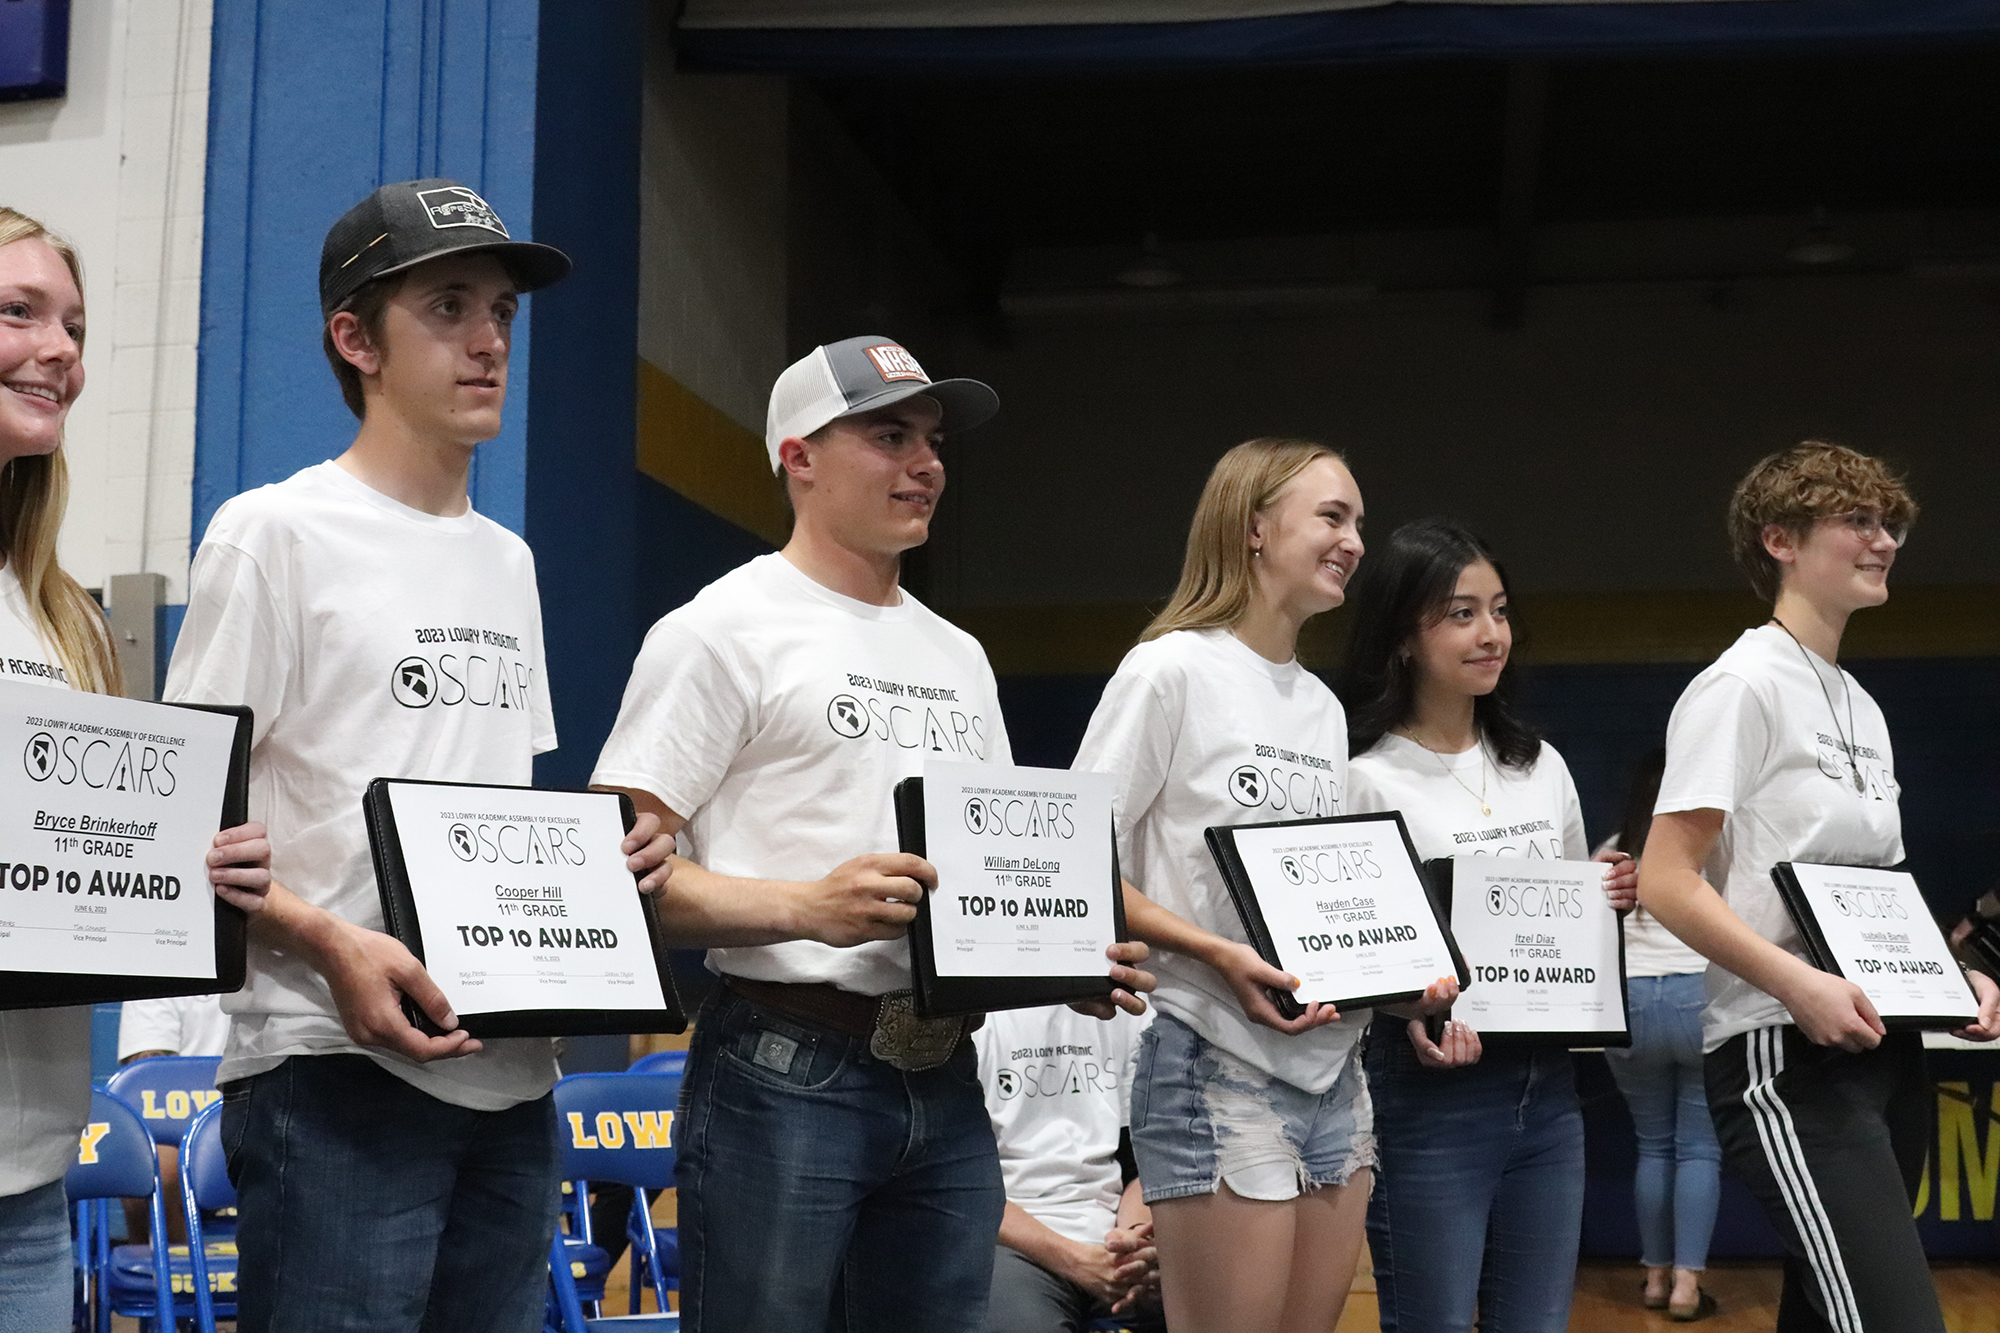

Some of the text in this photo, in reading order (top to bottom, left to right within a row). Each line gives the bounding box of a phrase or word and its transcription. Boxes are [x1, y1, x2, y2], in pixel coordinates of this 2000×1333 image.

[415, 627, 521, 652] 2023 LOWRY ACADEMIC
[8, 658, 68, 684] ACADEMIC
[846, 673, 959, 702] 2023 LOWRY ACADEMIC
[26, 716, 186, 747] 2023 LOWRY ACADEMIC ASSEMBLY OF EXCELLENCE
[827, 694, 984, 761] OSCARS
[1255, 743, 1277, 758] 2023
[24, 732, 178, 797] OSCARS
[961, 786, 973, 794] 2023
[974, 787, 991, 795] LOWRY
[992, 788, 1017, 797] ACADEMIC
[1017, 790, 1042, 798] ASSEMBLY
[1049, 792, 1077, 800] EXCELLENCE
[1228, 764, 1341, 817] OSCAR
[34, 810, 158, 837] Bryce Brinkerhoff
[456, 812, 476, 820] LOWRY
[478, 813, 508, 822] ACADEMIC
[509, 814, 538, 823] ASSEMBLY
[547, 816, 581, 825] EXCELLENCE
[964, 797, 1075, 839] OSCARS
[1453, 820, 1554, 844] 2023 LOWRY ACADEMIC
[54, 836, 134, 859] 11th GRADE
[448, 823, 586, 866] OSCARS
[984, 856, 1060, 873] William DeLong
[1280, 849, 1382, 885] OSCARS
[0, 862, 181, 901] TOP 10 AWARD
[495, 884, 562, 899] Cooper Hill
[995, 874, 1052, 888] 11th GRADE
[95, 906, 107, 914] 2023
[497, 903, 568, 917] 11th GRADE
[958, 895, 1089, 918] TOP 10 AWARD
[1316, 896, 1375, 911] Hayden Case
[1486, 885, 1582, 918] OSCARS
[1831, 890, 1908, 920] OSCARS
[1325, 910, 1377, 924] 11th GRADE
[85, 935, 107, 943] Principal
[456, 925, 618, 949] TOP 10 AWARD
[1297, 924, 1418, 953] TOP 10 AWARD
[1515, 933, 1555, 944] Itzel Diaz
[1510, 948, 1561, 959] 11th GRADE
[1885, 944, 1911, 954] GRADE
[1475, 966, 1596, 984] TOP 10 AWARD
[1855, 959, 1943, 975] TOP 10 AWARD
[1011, 1048, 1032, 1061] 2023
[997, 1058, 1118, 1100] OSCARS
